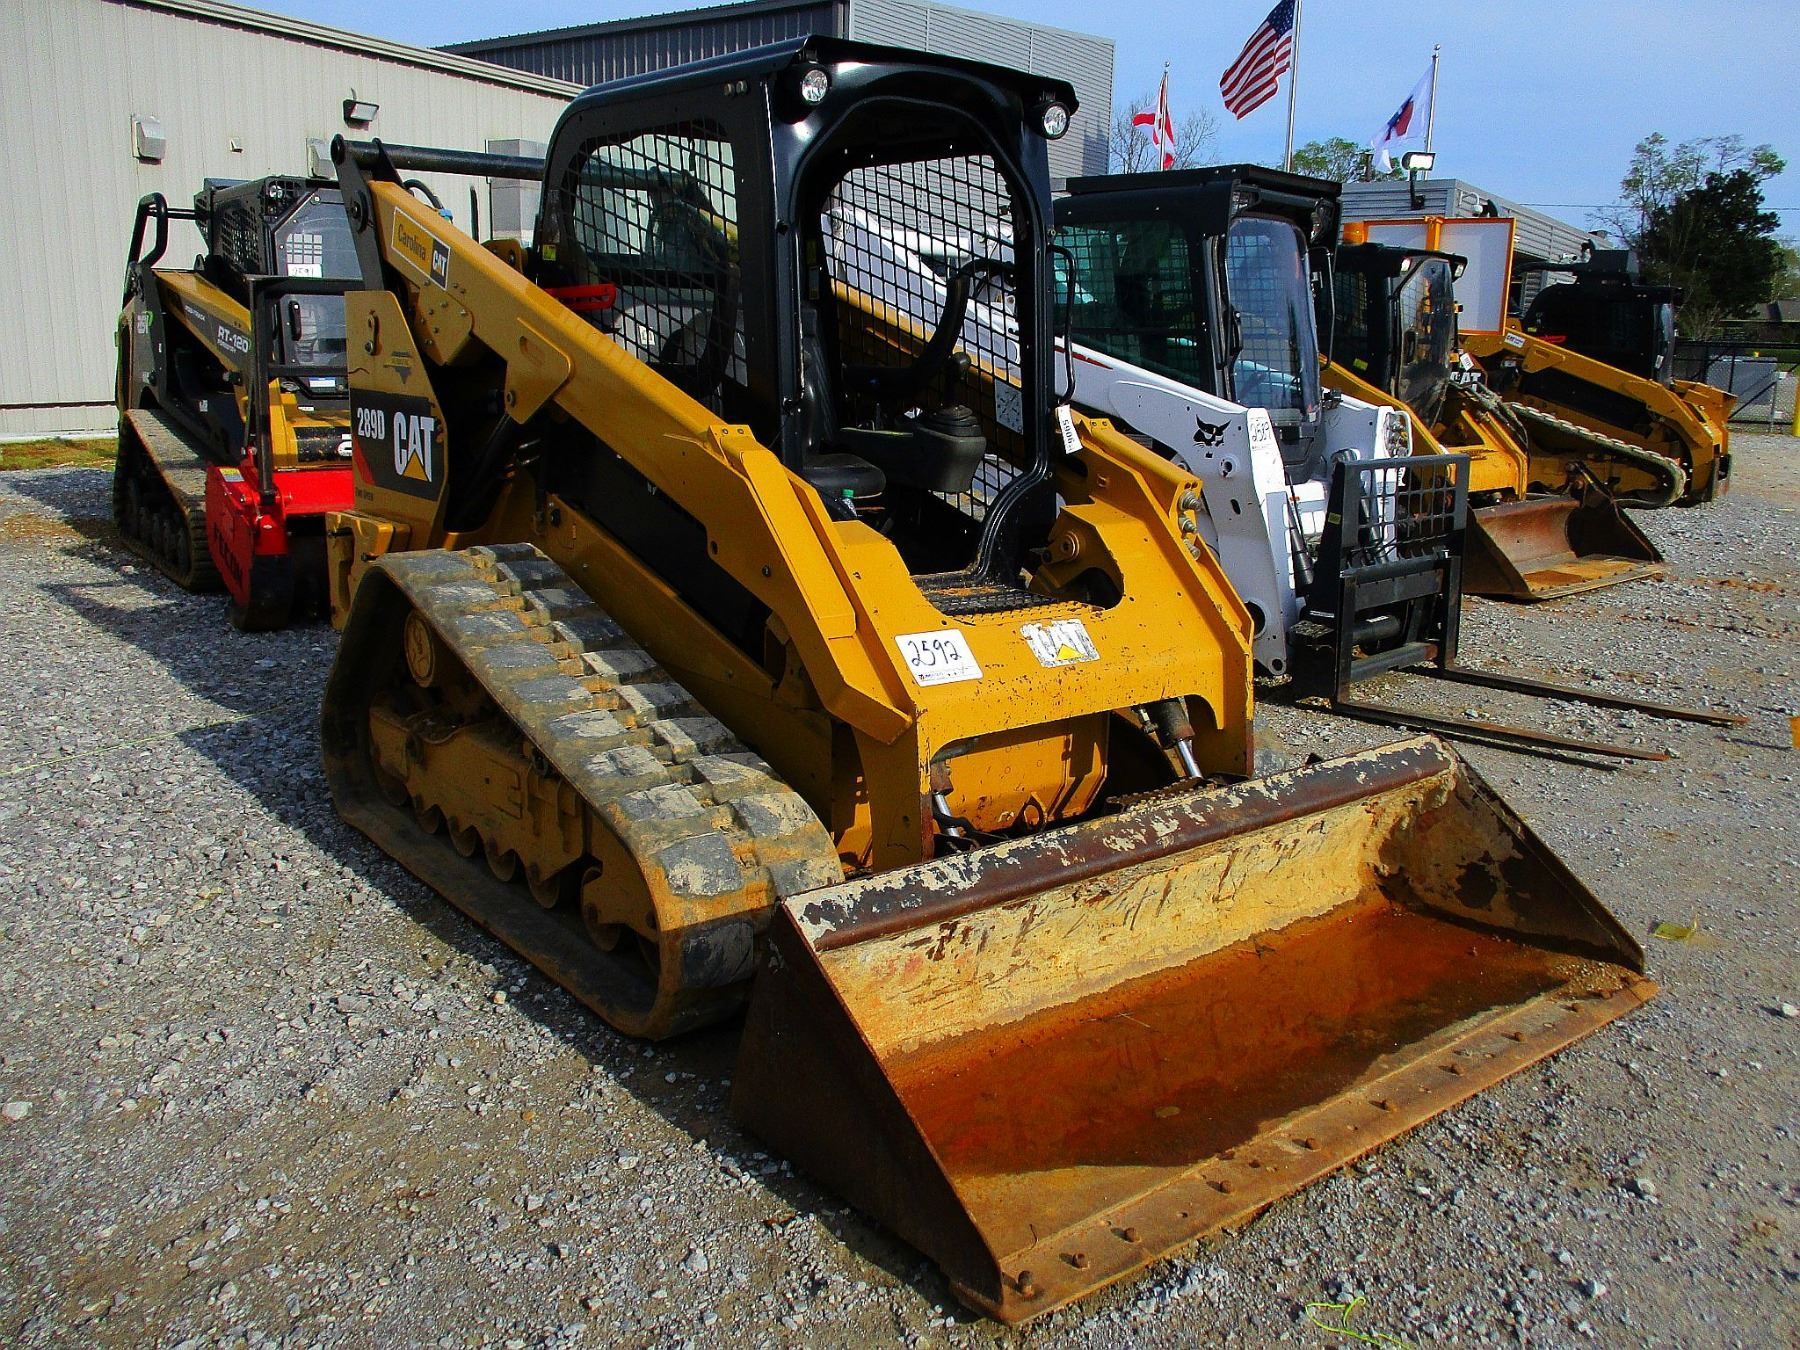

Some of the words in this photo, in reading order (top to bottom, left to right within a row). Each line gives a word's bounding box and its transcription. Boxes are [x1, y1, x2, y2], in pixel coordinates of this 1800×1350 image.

[398, 224, 424, 255] Carolina
[432, 244, 448, 277] CAT
[218, 325, 249, 353] RT-120
[357, 406, 386, 441] 289D
[393, 411, 435, 482] CAT
[907, 638, 963, 668] 2592
